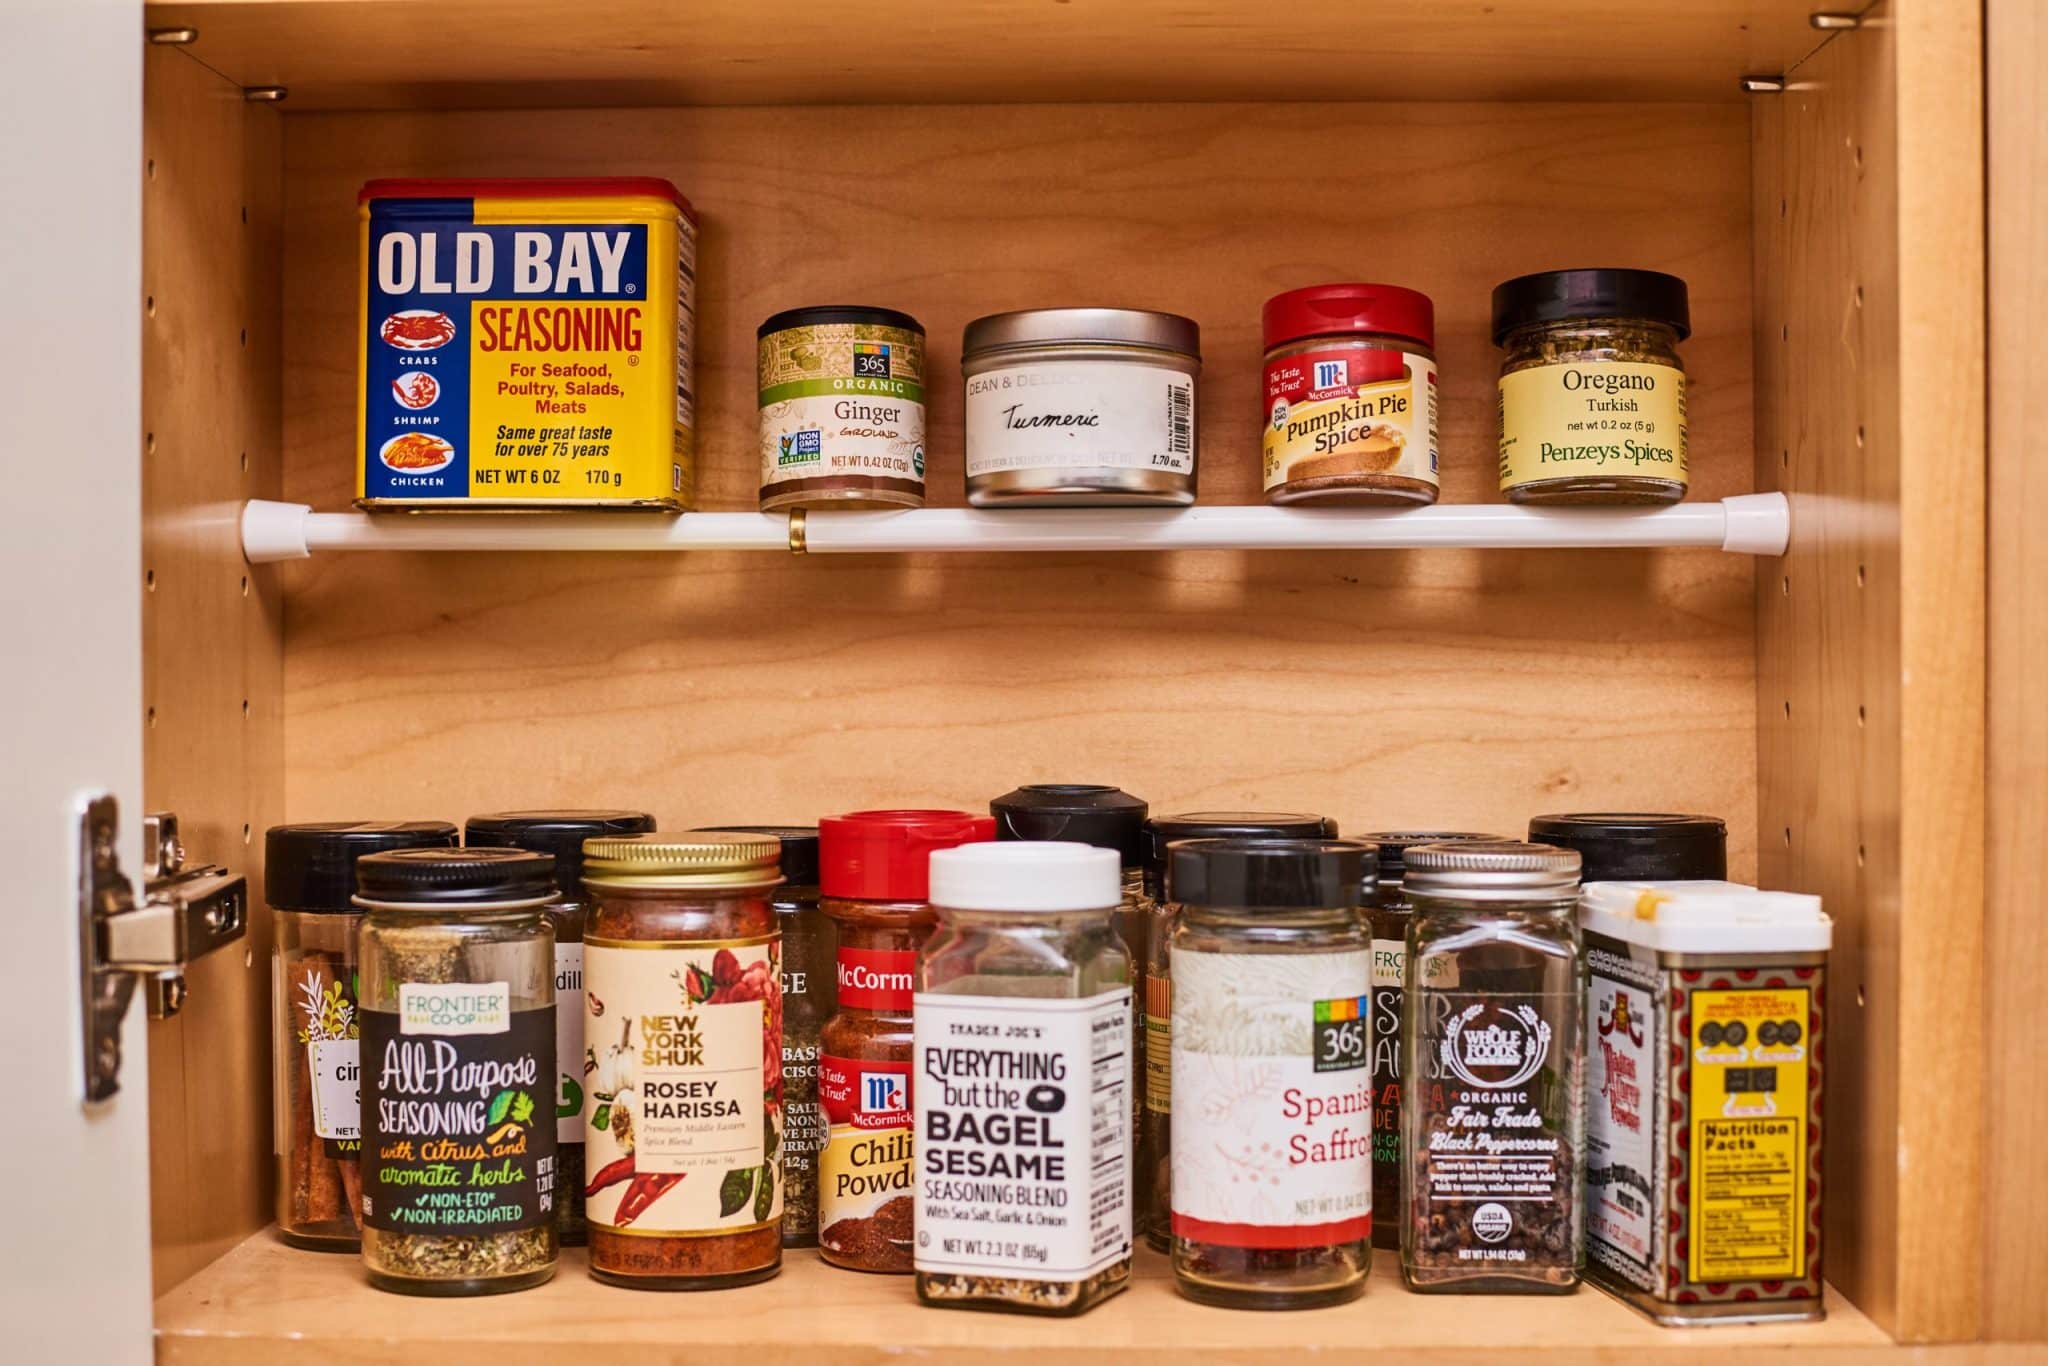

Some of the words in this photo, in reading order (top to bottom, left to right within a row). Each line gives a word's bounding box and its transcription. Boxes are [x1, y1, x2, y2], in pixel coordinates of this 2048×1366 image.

[378, 231, 494, 295] OLD
[479, 307, 642, 353] SEASONING
[399, 356, 438, 365] CRABS
[859, 355, 886, 373] 365
[510, 363, 537, 377] For
[541, 363, 613, 379] Seafood,
[1270, 372, 1280, 383] The
[1281, 368, 1300, 379] Taste
[497, 382, 558, 398] Poultry,
[565, 382, 625, 398] Salads,
[833, 379, 904, 392] ORGANIC
[969, 378, 998, 396] DEAN
[1002, 377, 1012, 388] &
[1563, 369, 1655, 394] Oregano
[1270, 386, 1280, 396] You
[1308, 386, 1353, 400] McCormick
[535, 400, 587, 414] Meats
[834, 401, 901, 425] Ginger
[1586, 398, 1638, 412] Turkish
[394, 416, 440, 425] SHRIMP
[1002, 404, 1100, 430] Turmeric
[1287, 401, 1374, 443] Pumpkin
[1379, 394, 1407, 415] Pie
[1567, 422, 1583, 431] net
[1586, 421, 1598, 430] wt
[1601, 420, 1617, 430] 0.2
[1620, 422, 1631, 430] oz
[497, 426, 535, 441] Same
[539, 427, 575, 445] great
[578, 426, 613, 440] taste
[799, 432, 819, 440] NON
[839, 427, 899, 439] GROUND
[1315, 425, 1371, 453] Spice
[495, 443, 517, 457] for
[519, 445, 548, 457] over
[552, 443, 569, 457] 75
[572, 445, 610, 460] years
[798, 439, 819, 447] GMO
[1151, 454, 1170, 465] 1.70
[1541, 442, 1620, 465] Penzeys
[1624, 439, 1673, 465] Spices
[831, 456, 846, 467] NET
[849, 456, 861, 467] WT
[864, 456, 881, 468] 0.42
[882, 457, 892, 468] OZ
[391, 477, 444, 486] CHICKEN
[475, 470, 501, 484] NET
[505, 470, 526, 484] WT
[530, 470, 539, 484] 6
[542, 470, 561, 484] OZ
[585, 470, 609, 484] 170
[612, 473, 622, 486] g
[555, 971, 582, 990] dill
[837, 961, 913, 990] McCorm
[406, 995, 499, 1012] FRONTIER
[431, 1013, 476, 1025] CO-OP
[641, 1015, 699, 1032] NEW
[950, 1023, 999, 1036] TRADER
[1463, 1025, 1521, 1045] WHOLE
[642, 1032, 704, 1049] YORK
[1322, 1022, 1364, 1061] 365
[642, 1050, 704, 1066] SHUK
[1466, 1044, 1520, 1058] FOODS
[378, 1039, 537, 1098] All-Purpose
[782, 1065, 819, 1078] CISC
[926, 1047, 1066, 1081] EVERYTHING
[826, 1068, 846, 1083] Taste
[644, 1081, 718, 1099] ROSEY
[943, 1080, 981, 1108] but
[984, 1080, 1021, 1110] the
[1460, 1091, 1528, 1104] ORGANIC
[644, 1100, 741, 1119] HARISSA
[1283, 1083, 1371, 1125] Spanis
[379, 1097, 488, 1136] SEASONING
[853, 1111, 914, 1127] McCormick
[1446, 1105, 1489, 1128] Fair
[1491, 1105, 1543, 1128] Trade
[336, 1127, 355, 1135] NET
[927, 1110, 1064, 1148] BAGEL
[1705, 1122, 1789, 1137] Nutrition
[380, 1142, 416, 1161] with
[493, 1136, 527, 1156] and
[850, 1133, 913, 1167] Chili
[1429, 1131, 1473, 1150] Black
[1474, 1132, 1559, 1155] Peppercorns
[1705, 1138, 1755, 1150] Facts
[785, 1157, 809, 1170] 12g
[925, 1149, 1065, 1181] SESAME
[380, 1162, 462, 1187] aromatic
[469, 1159, 526, 1187] herbs
[837, 1162, 914, 1197] Powd
[924, 1179, 1014, 1204] SEASONING
[1016, 1185, 1068, 1207] BLEND
[404, 1206, 522, 1225] NON-IRRADIATED
[926, 1205, 949, 1218] With
[951, 1207, 969, 1220] Sea
[971, 1207, 994, 1223] Salt,
[996, 1209, 1023, 1223] Garlic
[1026, 1212, 1034, 1225] &
[1036, 1212, 1067, 1227] Onion
[1480, 1212, 1504, 1220] USDA
[943, 1239, 962, 1253] NET
[1005, 1242, 1019, 1257] OZ
